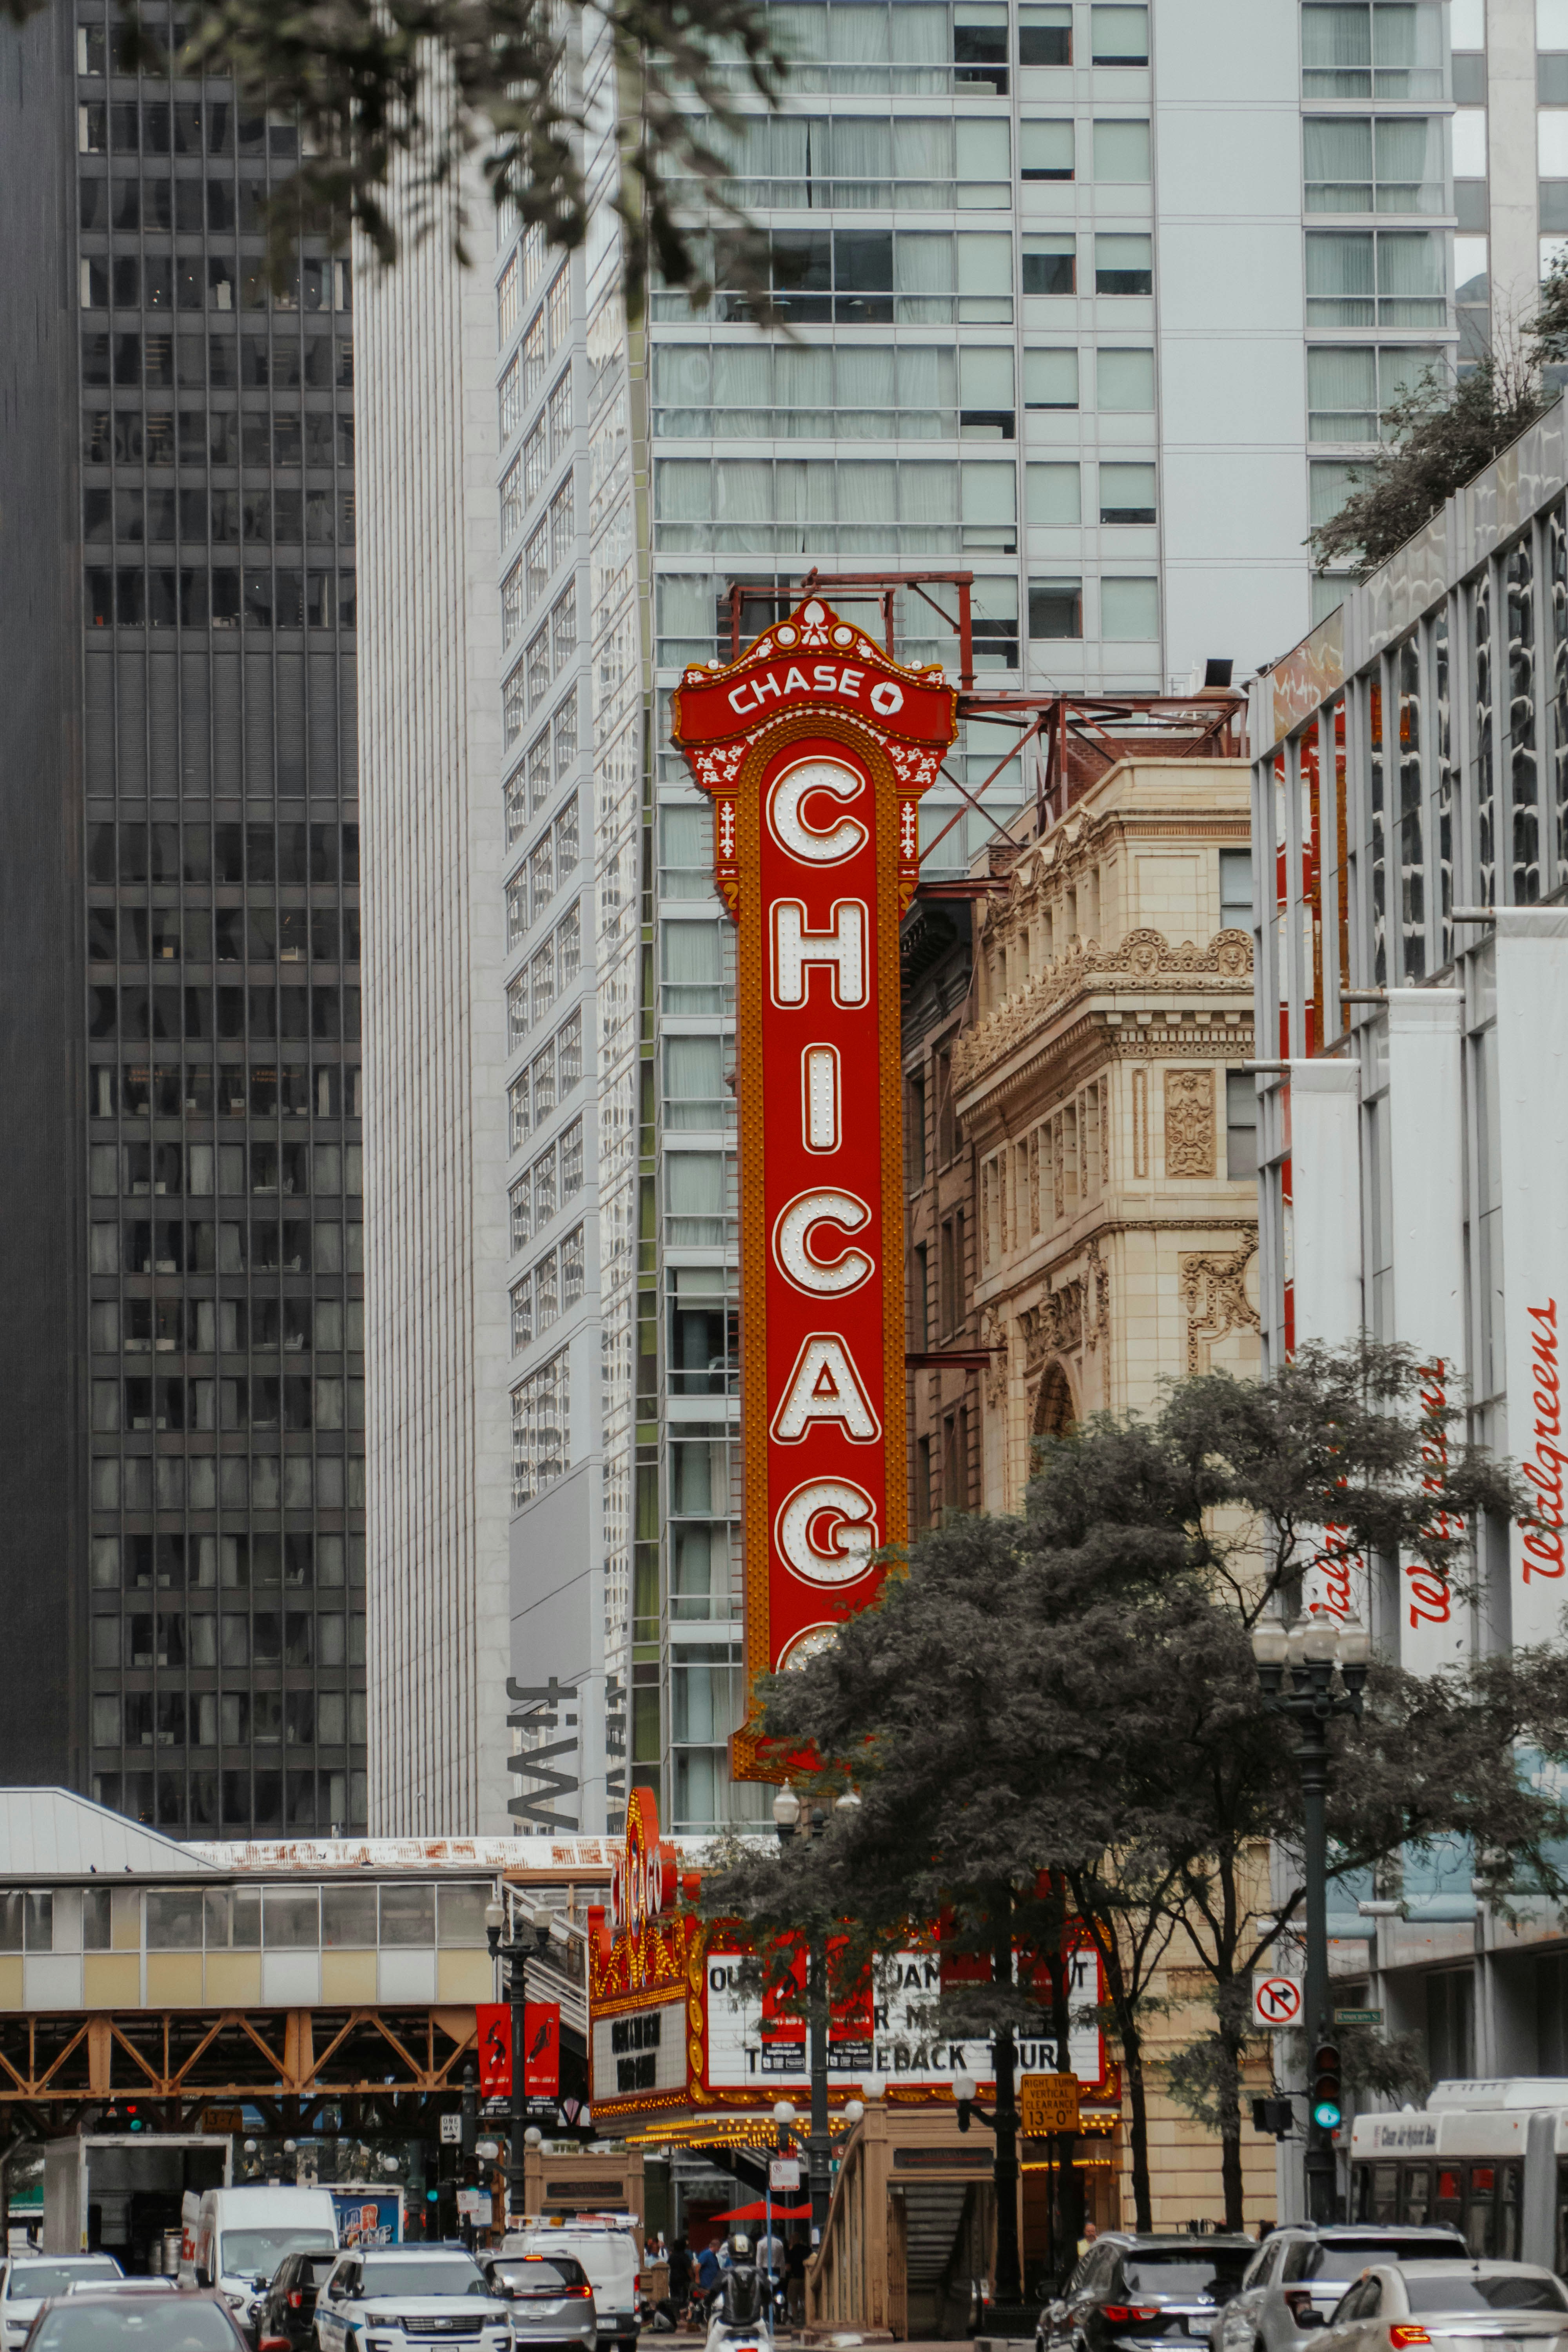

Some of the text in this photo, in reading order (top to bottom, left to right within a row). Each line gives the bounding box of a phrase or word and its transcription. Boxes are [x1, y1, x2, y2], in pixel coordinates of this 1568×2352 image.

[726, 665, 865, 715] CHASE
[506, 1677, 579, 1831] Wit
[1024, 2078, 1075, 2088] RIGHT TURN
[1031, 2089, 1069, 2098] VERTICAL
[1025, 2100, 1075, 2110] CLEARANCE
